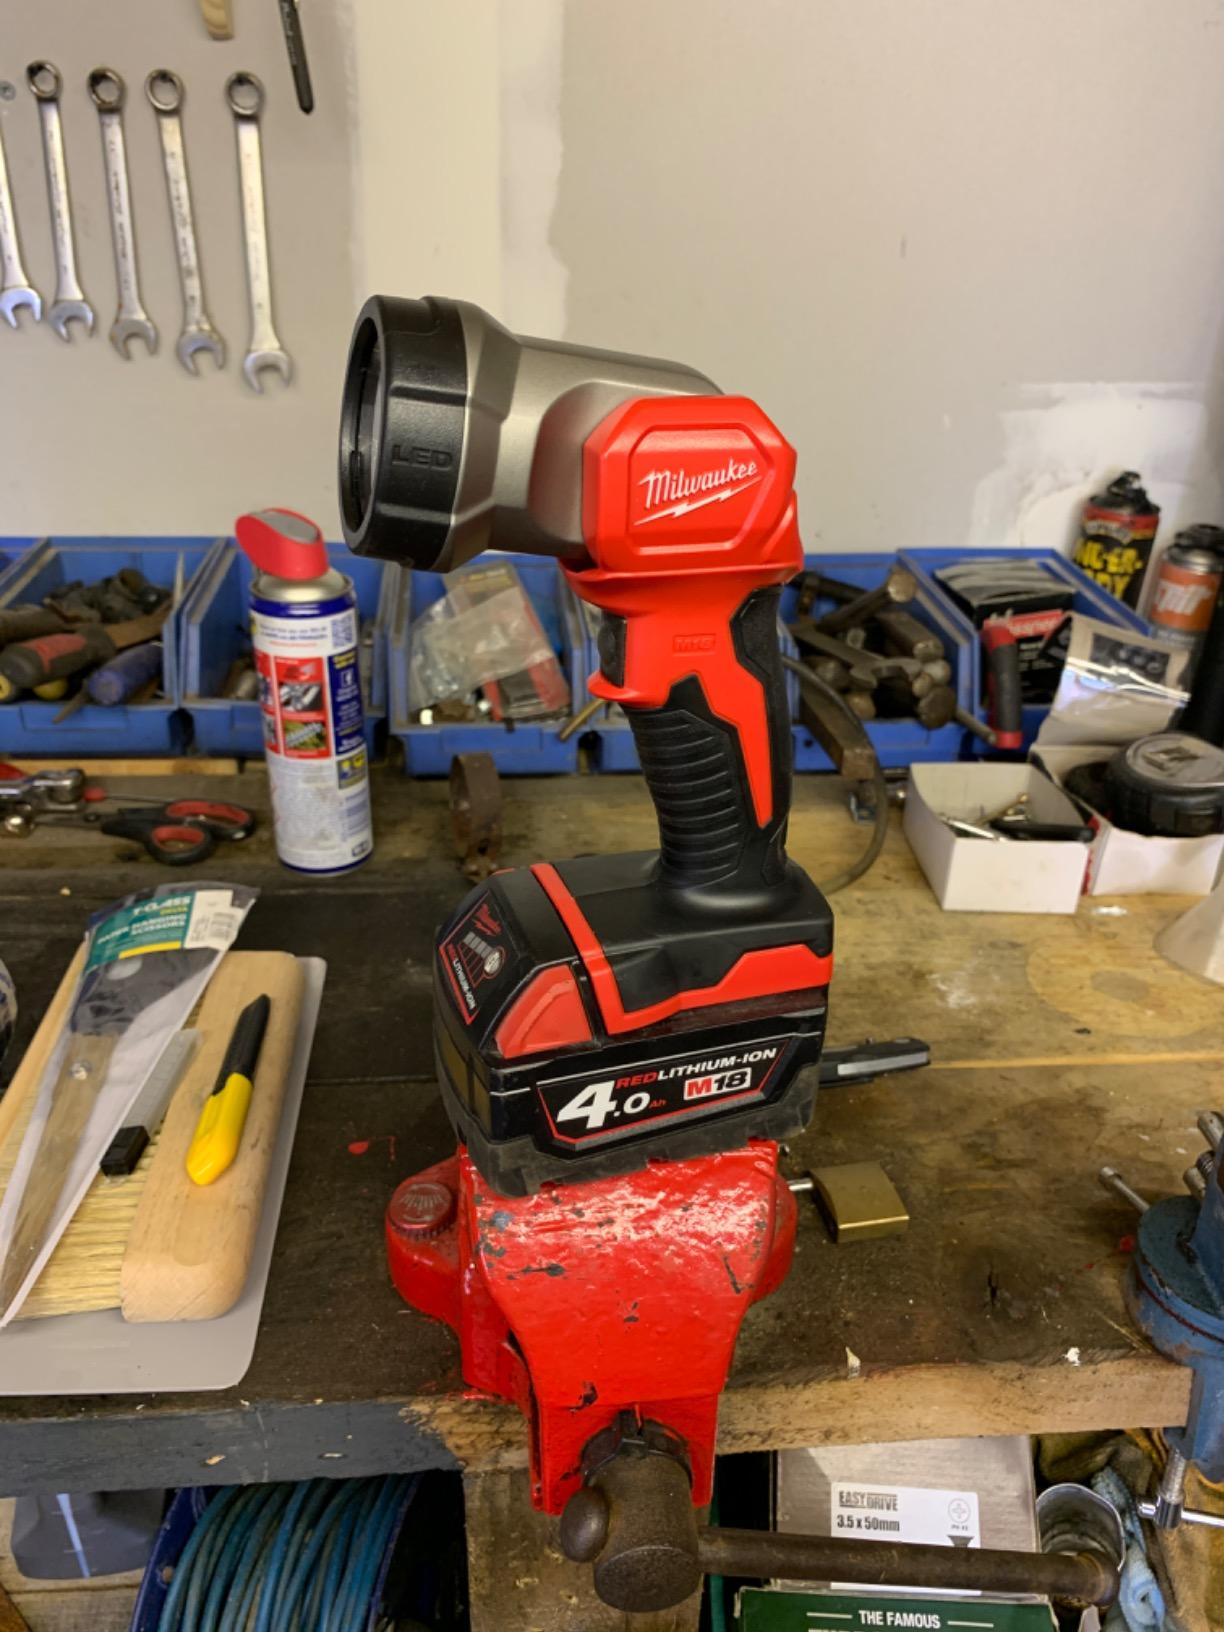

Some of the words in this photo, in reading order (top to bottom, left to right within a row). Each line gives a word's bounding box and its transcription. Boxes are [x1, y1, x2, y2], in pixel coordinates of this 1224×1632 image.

[392, 444, 453, 471] LED
[637, 458, 759, 510] Milwaukee
[687, 1071, 748, 1098] M18
[837, 1514, 854, 1529] 3.5
[856, 1518, 862, 1529] x
[864, 1516, 900, 1532] 50mm
[859, 1610, 884, 1625] THE
[886, 1611, 941, 1629] FAMOUS
